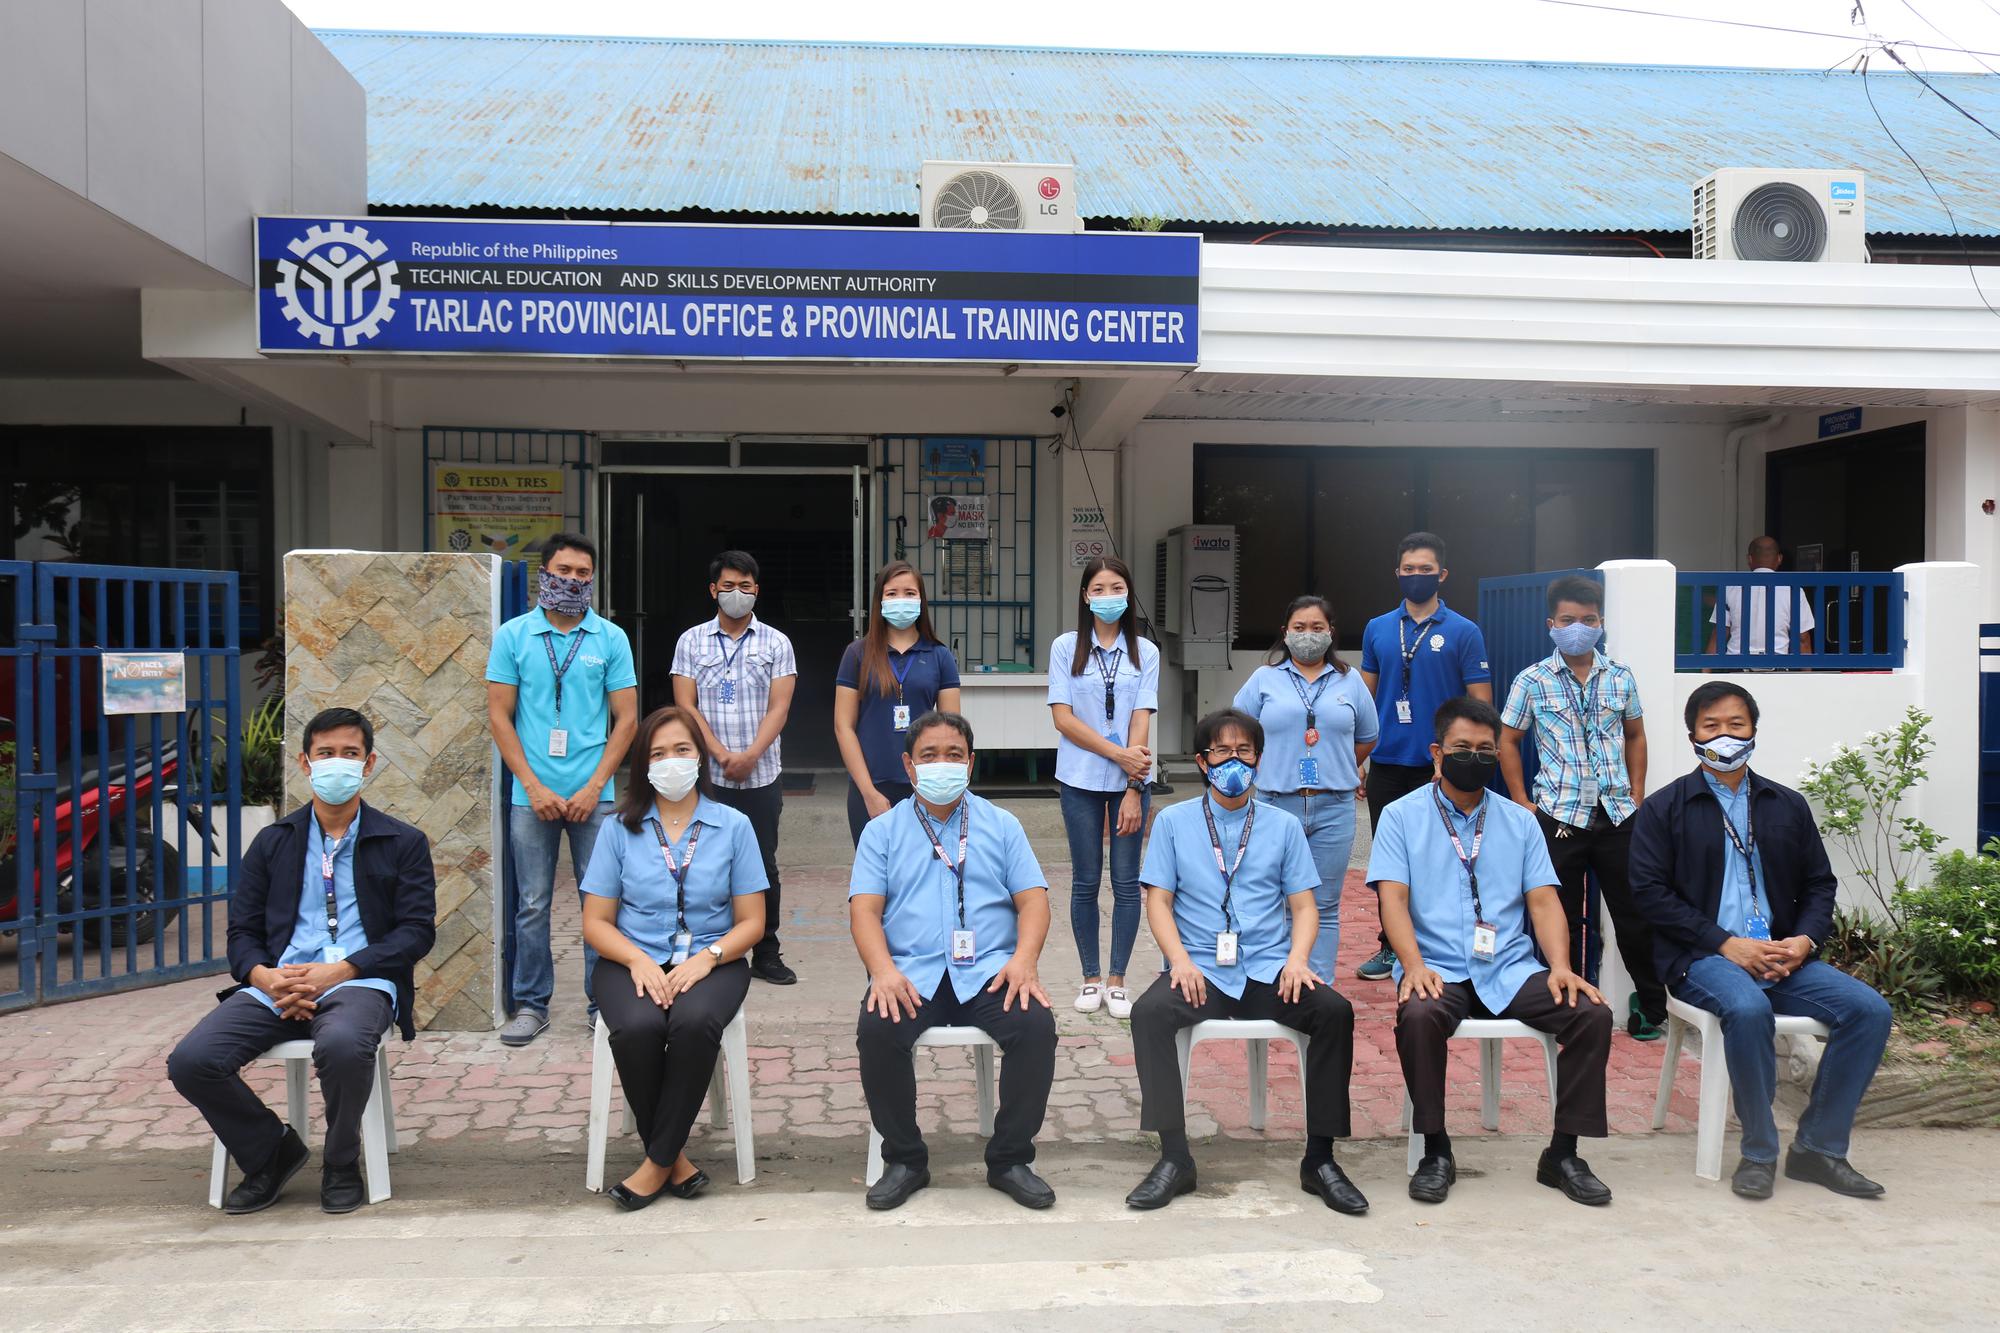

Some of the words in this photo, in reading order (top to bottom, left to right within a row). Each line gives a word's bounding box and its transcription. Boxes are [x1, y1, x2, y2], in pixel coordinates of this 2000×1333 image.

[1040, 203, 1058, 215] LG
[411, 241, 480, 260] Republic
[483, 242, 501, 258] of
[503, 243, 529, 258] the
[533, 243, 618, 262] Philippines
[409, 268, 503, 286] TECHNICAL
[506, 270, 602, 287] EDUCATION
[620, 272, 659, 288] AND
[667, 273, 719, 289] SKILLS
[723, 274, 843, 291] DEVELOPMENT
[845, 276, 937, 293] AUTHORITY
[410, 298, 513, 334] TARLAC
[521, 299, 677, 336] PROVINCIAL
[682, 302, 773, 338] OFFICE
[780, 304, 799, 338] &
[805, 304, 957, 340] PROVINCIAL
[962, 306, 1079, 342] TRAINING
[1087, 309, 1185, 344] CENTER
[467, 476, 509, 487] TESDA
[516, 477, 548, 488] TRES
[969, 503, 985, 511] FACE
[958, 511, 985, 520] MASK
[1196, 536, 1230, 547] iwata
